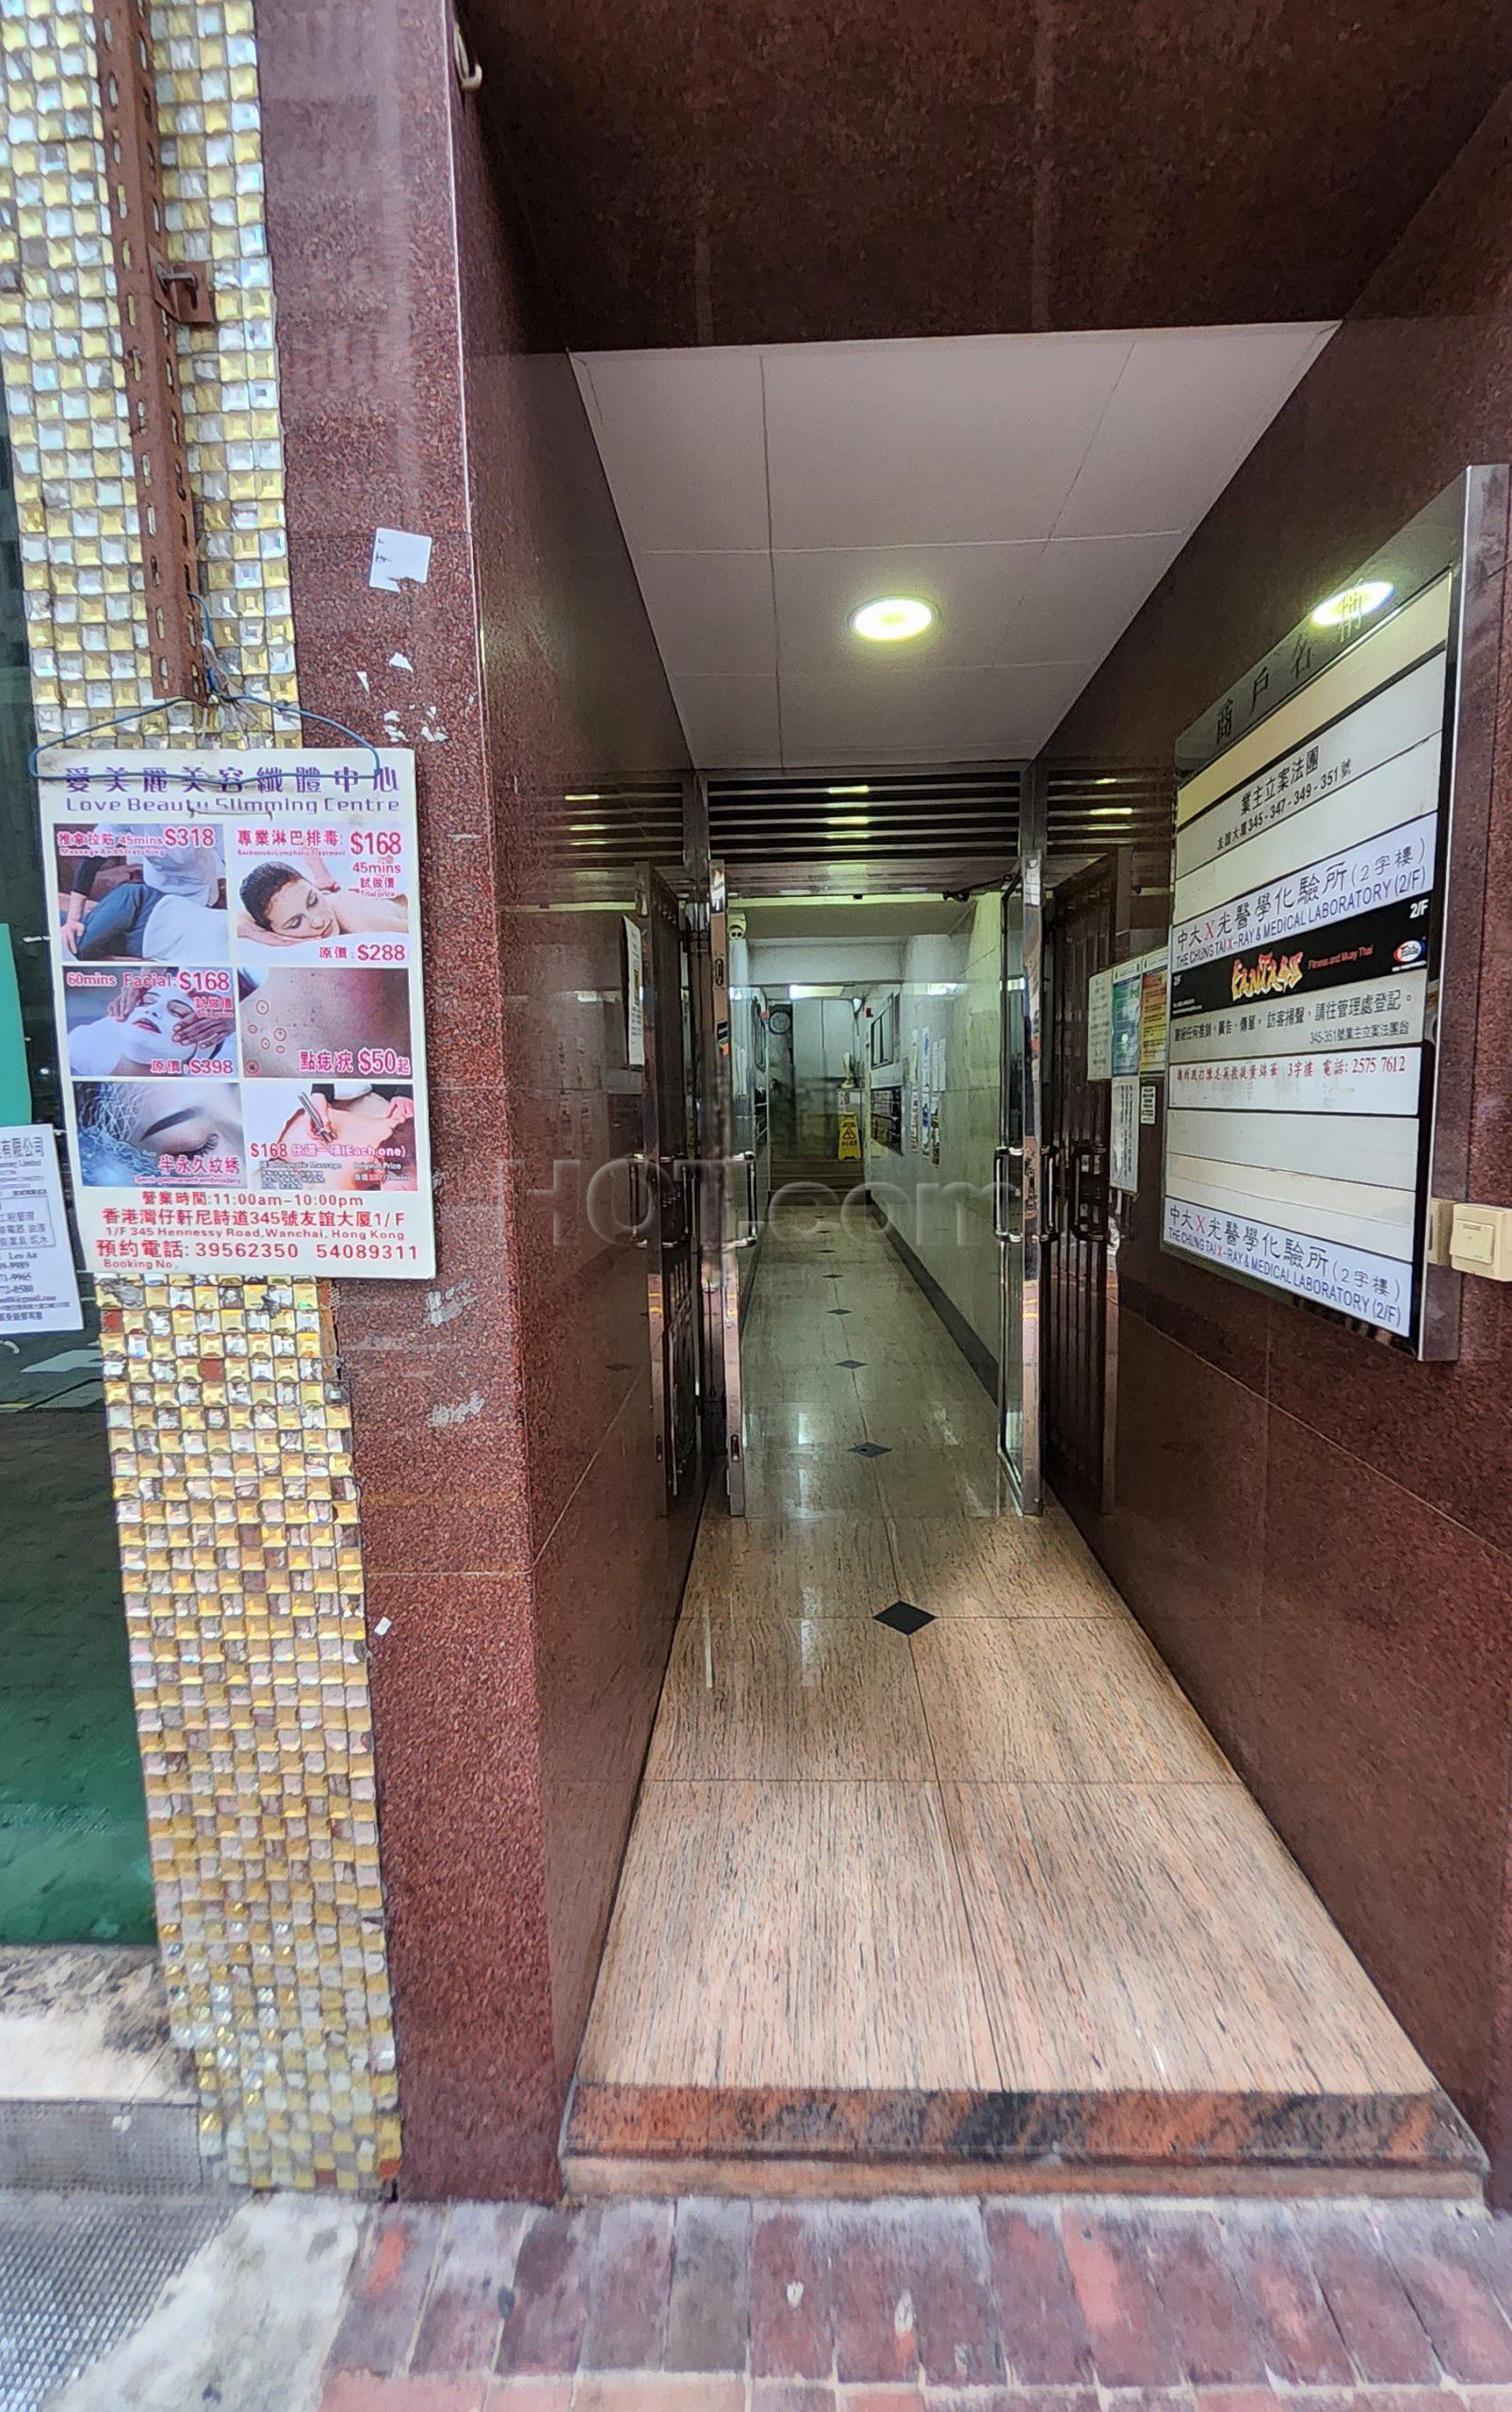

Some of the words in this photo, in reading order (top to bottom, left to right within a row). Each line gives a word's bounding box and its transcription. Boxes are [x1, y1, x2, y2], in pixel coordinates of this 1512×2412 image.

[66, 766, 399, 793] 愛美麗美容纖體中心
[1241, 745, 1319, 816] 業主立案法團
[66, 797, 121, 811] Love
[128, 797, 208, 814] Beauty
[216, 797, 317, 814] Slimming
[324, 797, 399, 812] Centre
[120, 835, 163, 845] 45mins
[165, 827, 214, 847] $318
[350, 831, 402, 856] $168
[353, 862, 401, 873] 45mins
[1176, 953, 1189, 969] THE
[1215, 939, 1227, 956] TAI
[1227, 929, 1255, 950] X-RAY
[1256, 928, 1261, 940] &
[1264, 911, 1307, 937] MEDICAL
[1309, 879, 1391, 922] LABORATORY
[1394, 866, 1426, 897] (2/F)
[1409, 899, 1429, 919] 2/F
[357, 944, 406, 960] $288
[67, 972, 116, 986] 60mins
[179, 971, 230, 990] $168
[190, 1059, 234, 1075] $398
[1352, 1057, 1376, 1073] 2575
[1381, 1055, 1406, 1072] 7612
[0, 1136, 44, 1158] 有限公司
[251, 1143, 288, 1158] $168
[106, 1227, 126, 1236] 1/F
[131, 1228, 154, 1236] 345
[158, 1228, 222, 1238] Hennessy
[332, 1230, 366, 1241] Hong
[370, 1230, 405, 1241] Kong
[196, 1243, 299, 1258] 39562350
[317, 1244, 418, 1260] 54089311
[104, 1260, 153, 1270] Booking
[1205, 1240, 1216, 1255] TAI
[1216, 1246, 1244, 1264] X-RAY
[1244, 1256, 1249, 1268] &
[1251, 1258, 1293, 1284] MEDICAL
[1293, 1271, 1371, 1313] LABORATORY
[1373, 1297, 1402, 1328] (2/F)
